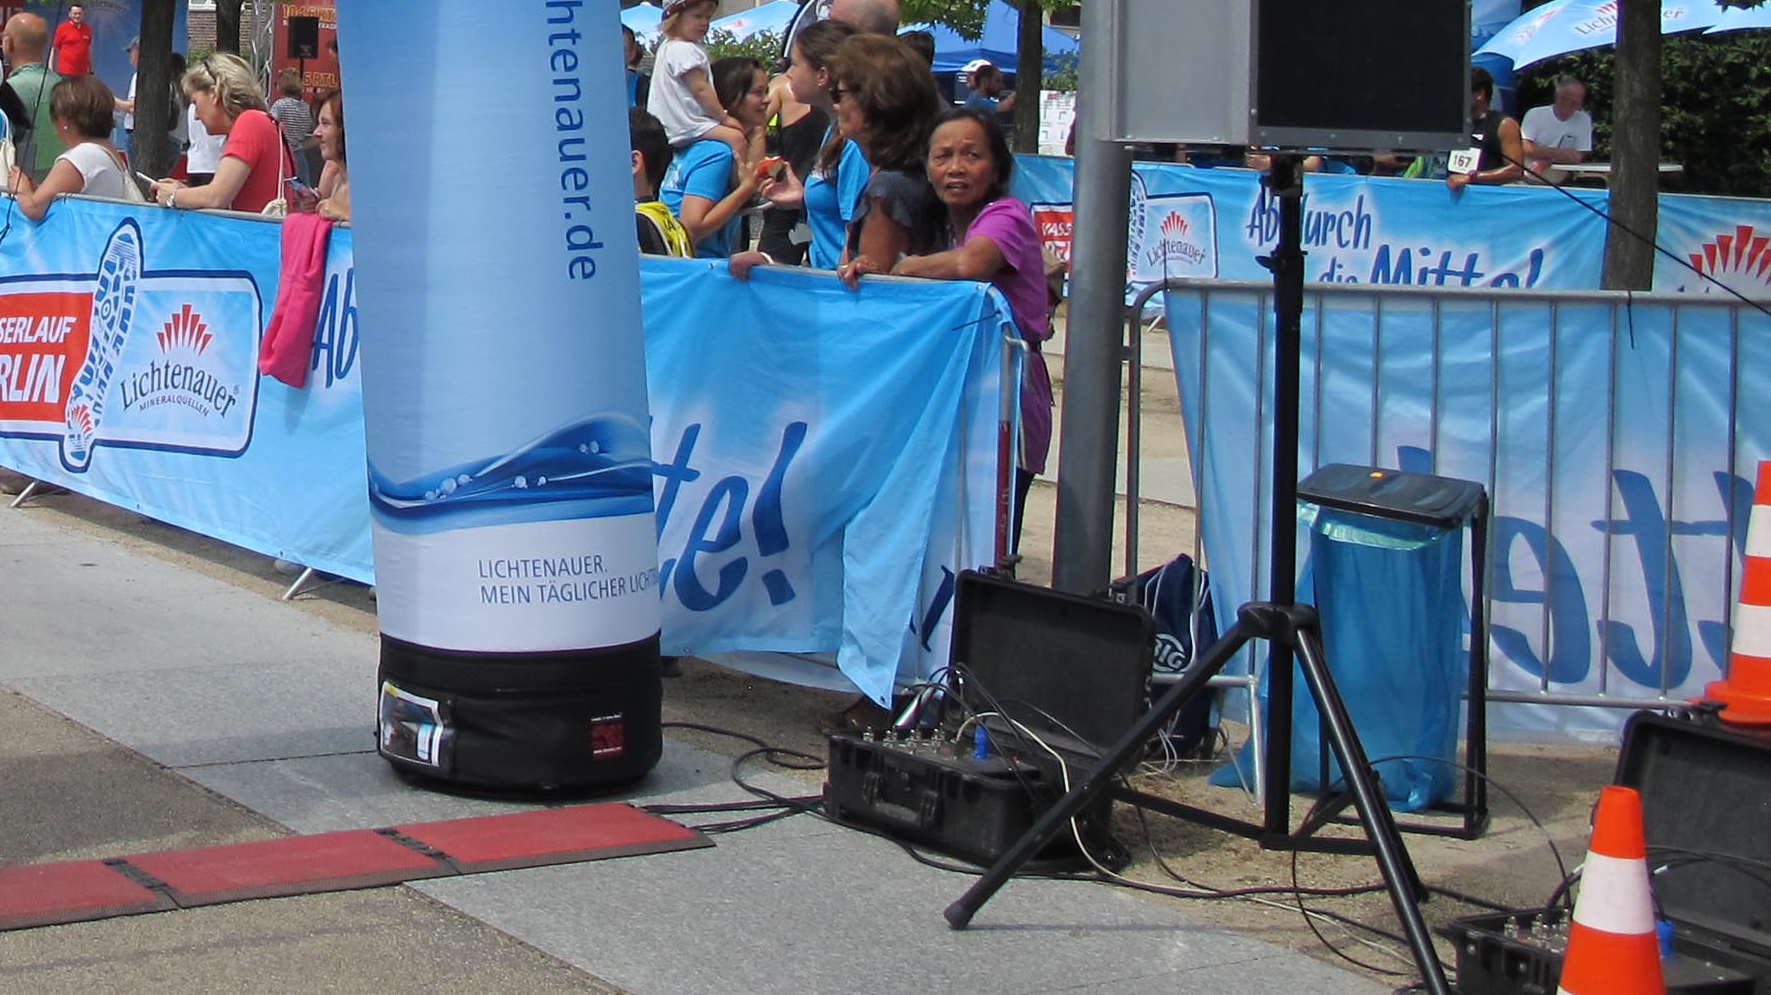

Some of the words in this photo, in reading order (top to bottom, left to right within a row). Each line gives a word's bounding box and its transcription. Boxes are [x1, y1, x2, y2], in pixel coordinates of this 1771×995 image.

[1453, 155, 1472, 168] 167
[311, 267, 359, 389] Ab
[120, 359, 237, 419] Lichtenauer
[139, 394, 210, 417] MINERALQUELLEN
[478, 555, 608, 579] LICHTENAUER.
[480, 584, 531, 605] MEIN
[537, 576, 626, 604] TÄGLICHER
